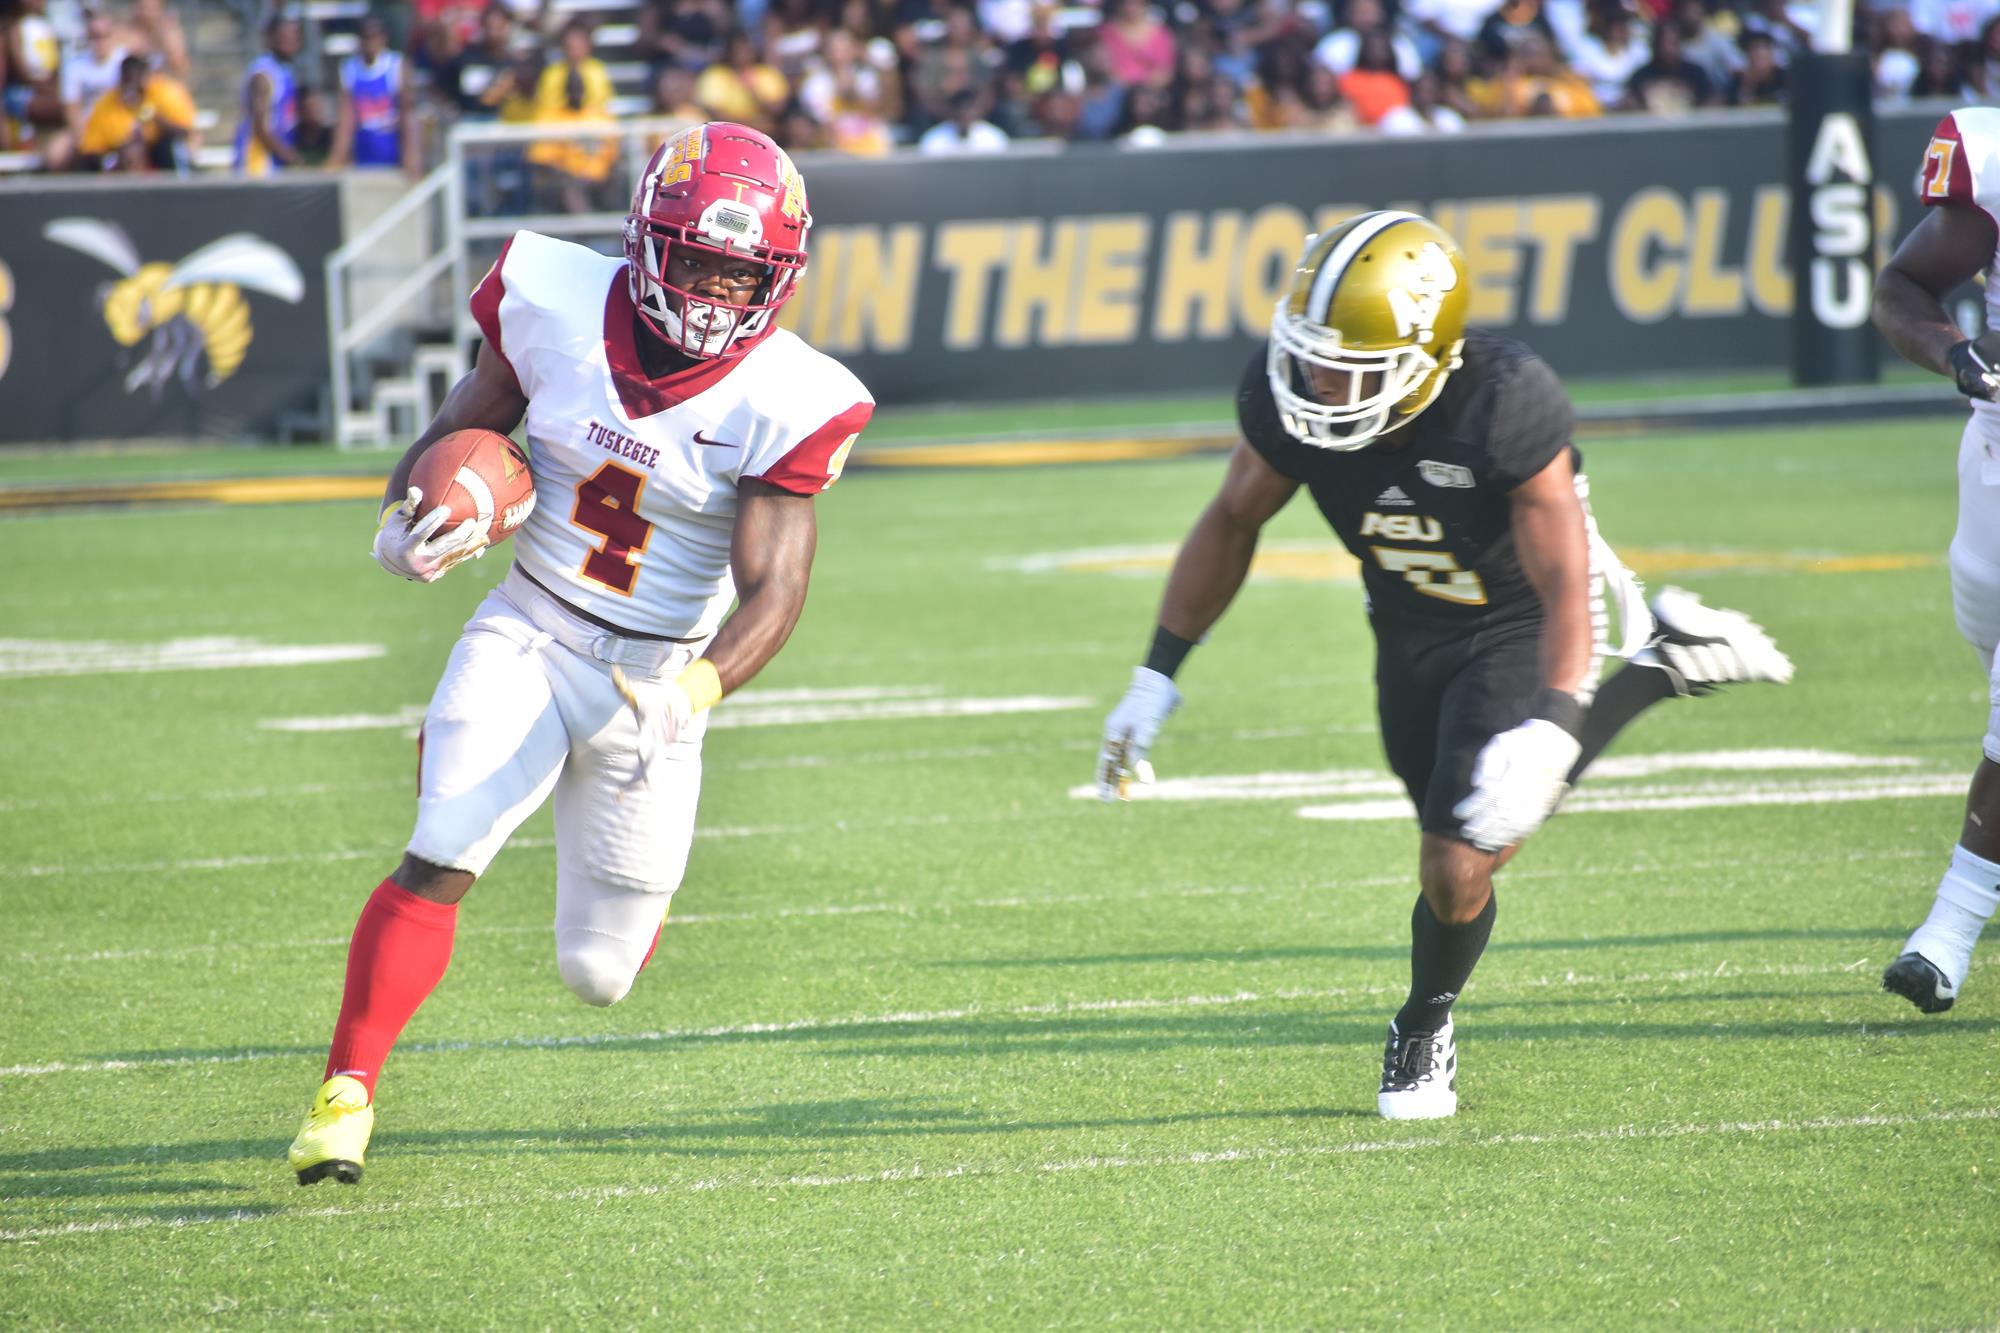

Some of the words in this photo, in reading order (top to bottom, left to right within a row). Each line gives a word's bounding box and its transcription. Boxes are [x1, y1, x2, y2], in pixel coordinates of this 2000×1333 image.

[783, 226, 919, 354] IN
[934, 214, 1153, 350] THE
[1153, 193, 1602, 342] HOET
[1806, 112, 1872, 329] ASU
[585, 420, 660, 470] TUSKEGEE
[570, 458, 655, 597] 4
[1359, 511, 1444, 542] ASU
